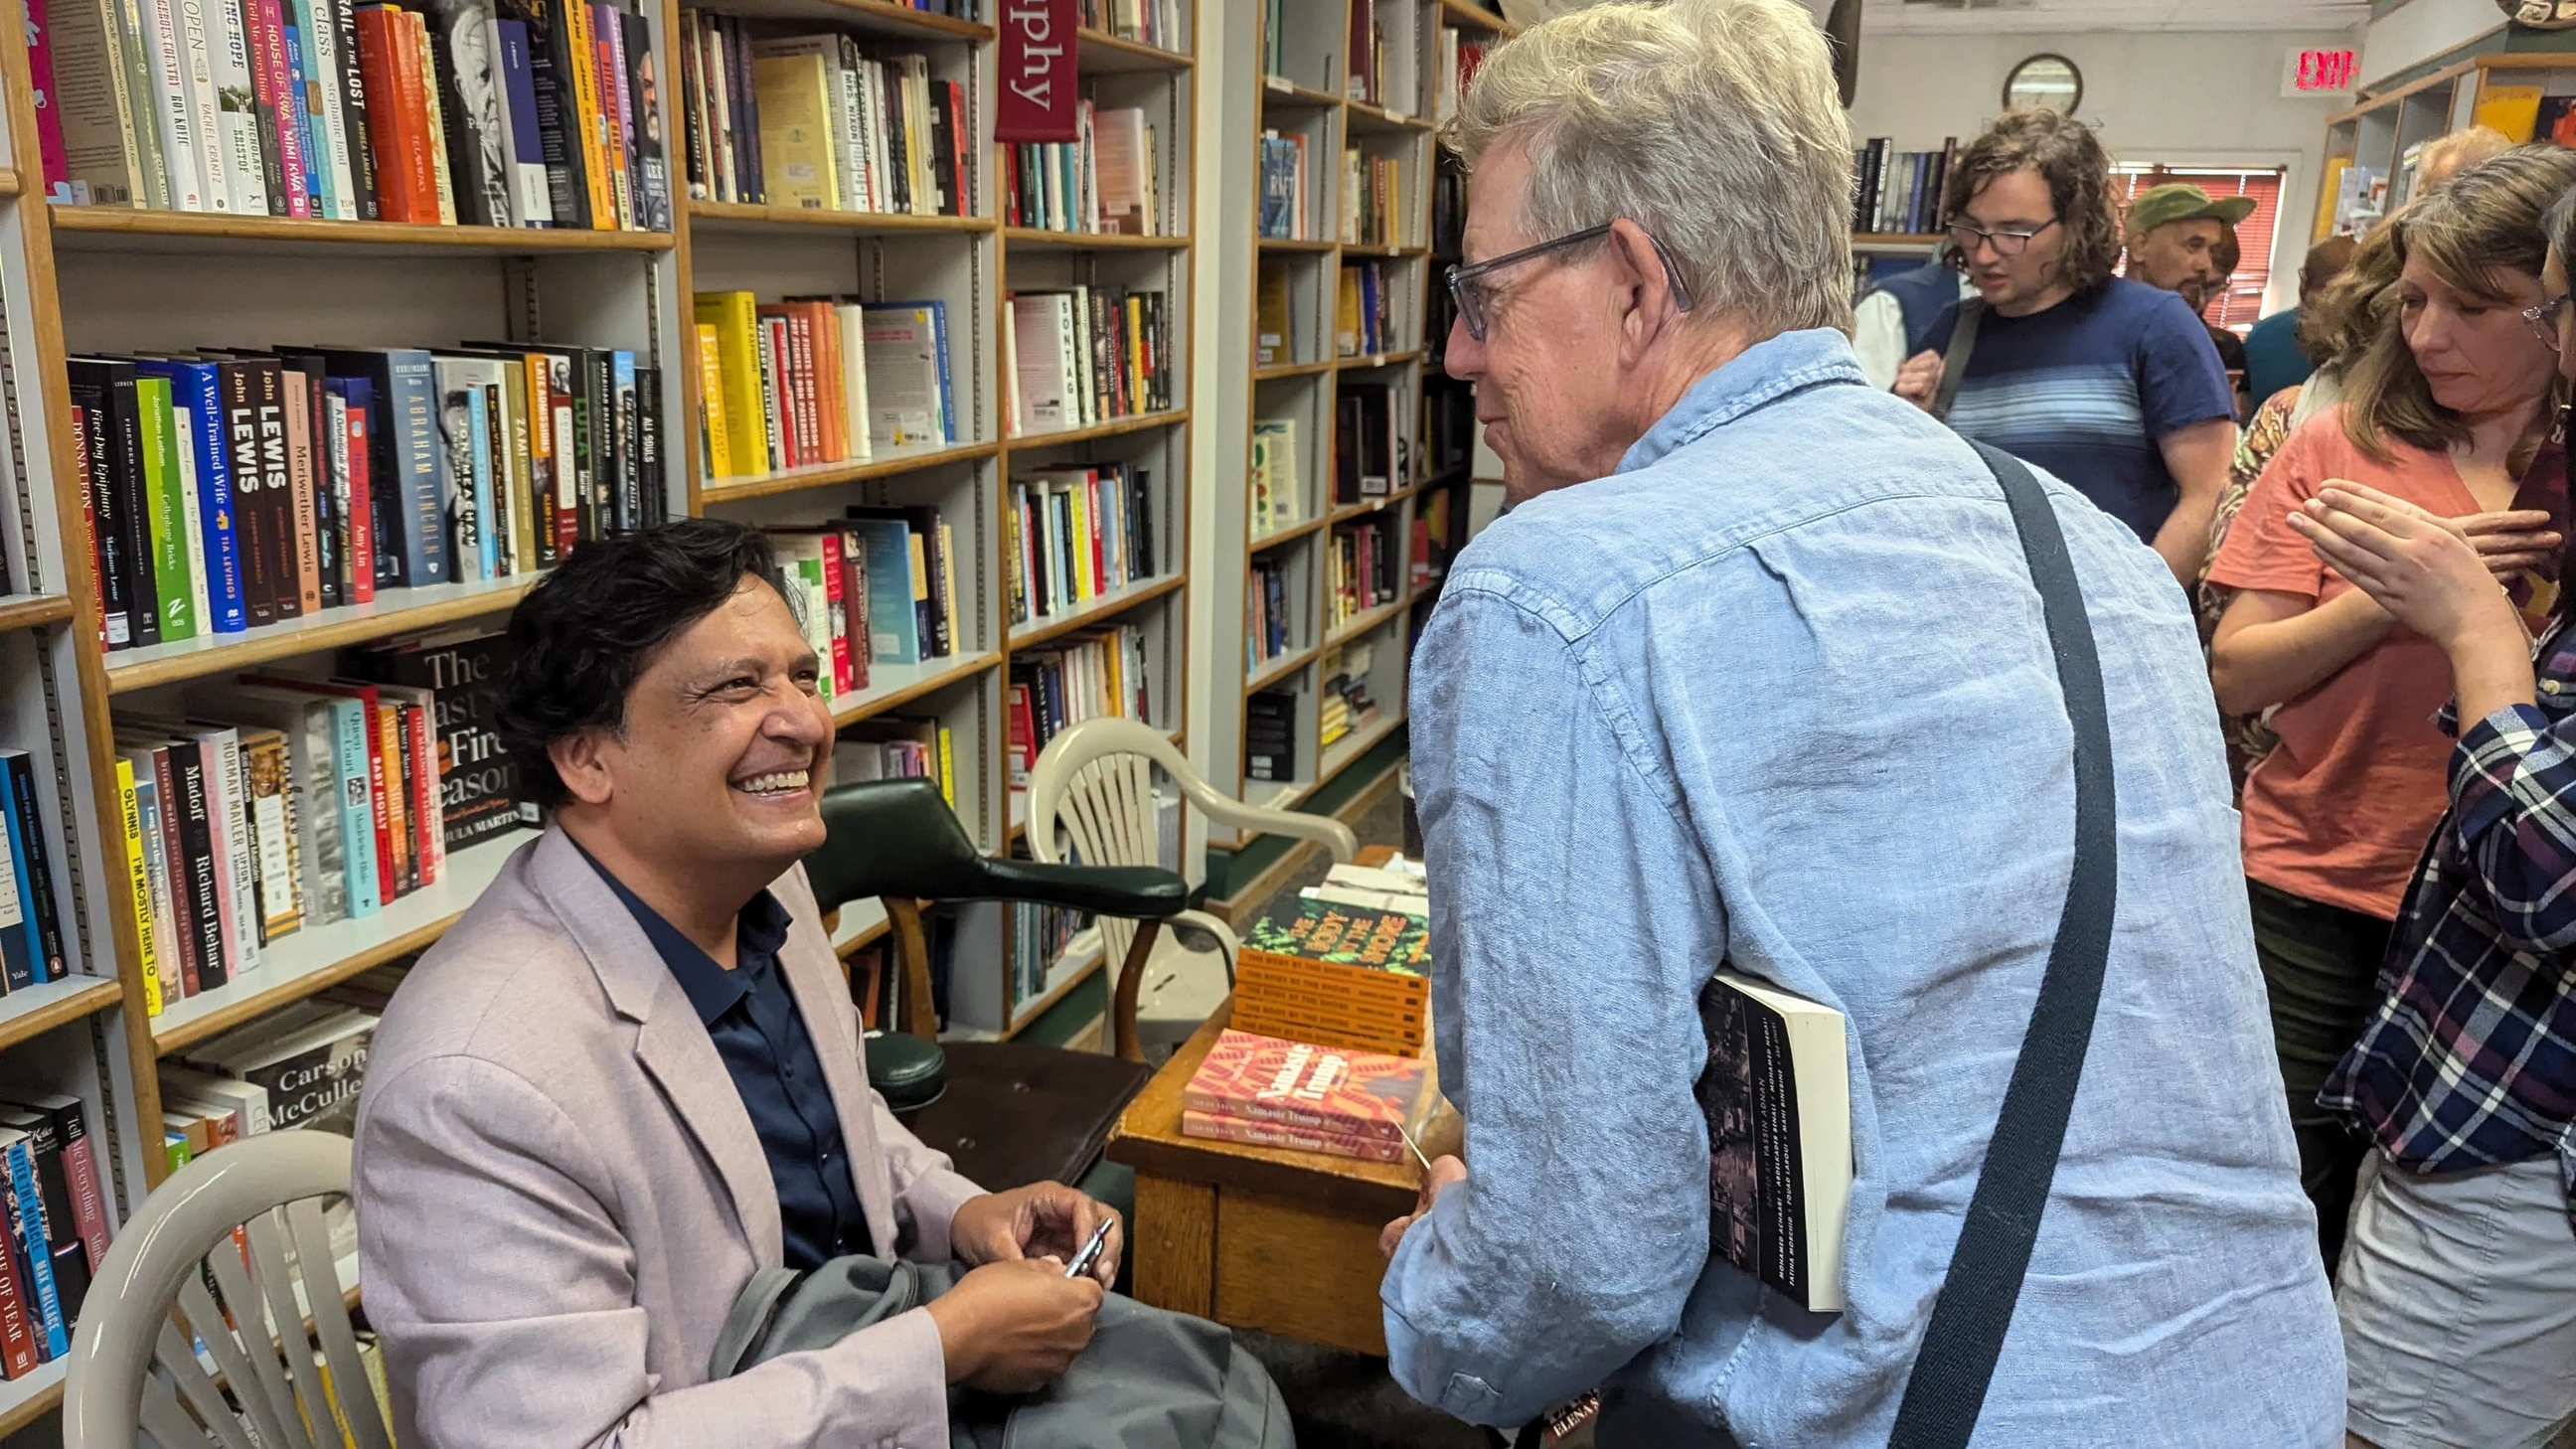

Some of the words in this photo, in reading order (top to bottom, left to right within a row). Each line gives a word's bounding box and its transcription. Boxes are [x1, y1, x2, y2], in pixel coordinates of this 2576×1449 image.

[184, 2, 205, 51] OPEN
[340, 0, 355, 32] RAIL
[229, 30, 244, 69] HOPE
[266, 24, 283, 68] HOUSE
[346, 36, 355, 46] OF
[348, 50, 358, 66] THE
[163, 43, 180, 87] COUNTRY
[253, 44, 267, 101] Everything
[274, 71, 287, 87] OF
[602, 61, 614, 96] BITING
[2298, 51, 2353, 89] EXIT
[171, 95, 184, 113] RON
[277, 89, 291, 120] KWA
[316, 7, 332, 57] class
[328, 82, 343, 138] stephanie
[336, 141, 347, 166] land
[348, 69, 365, 109] LOST
[202, 103, 215, 140] RACHEL
[607, 100, 617, 119] THE
[848, 105, 857, 139] NIXON
[174, 118, 189, 146] KOVIC
[247, 120, 260, 170] NICHOLAS
[283, 130, 297, 159] MIMI
[610, 124, 621, 152] HAND
[208, 144, 223, 183] KRANTZ
[234, 129, 248, 173] KRISTOF
[288, 162, 301, 192] KWA
[799, 317, 808, 335] TOY
[792, 337, 801, 370] FIGHTS
[801, 336, 811, 369] FIGHTS
[1061, 302, 1075, 396] SONTAG
[201, 371, 212, 381] A
[234, 372, 245, 402] John
[261, 370, 274, 401] John
[536, 362, 547, 390] LATE
[701, 334, 721, 418] Eileen
[805, 379, 814, 398] DON
[151, 396, 164, 433] Jonathan
[201, 382, 224, 469] Well-Trained
[408, 394, 431, 472] ABRAHAM
[538, 391, 551, 453] ADMISSIONS
[573, 398, 588, 456] LULA
[72, 421, 87, 470] DONNA
[87, 407, 107, 460] Five-Dog
[124, 417, 134, 464] FIREWEED
[231, 407, 258, 493] LEWIS
[258, 405, 287, 490] LEWIS
[459, 418, 469, 451] JON
[516, 418, 527, 456] ZAMI
[642, 434, 654, 462] SOULS
[766, 420, 775, 447] PAGE
[353, 453, 363, 474] Here
[79, 473, 92, 510] LEON
[93, 462, 113, 520] Epiphany
[213, 473, 228, 505] Wife
[294, 444, 312, 528] Meriwether
[354, 481, 365, 508] After
[159, 493, 175, 543] Cellophane
[417, 483, 439, 554] LINCOLN
[462, 464, 475, 547] MEACHAM
[105, 536, 116, 572] Marianne
[220, 534, 230, 551] TIA
[301, 533, 315, 572] Lewis
[353, 525, 366, 547] Amy
[166, 544, 177, 570] Bricks
[357, 551, 367, 566] Lin
[109, 575, 120, 600] Leone
[222, 555, 236, 598] LEVINGS
[424, 651, 490, 690] The
[435, 691, 478, 727] ast
[384, 716, 397, 749] WEST
[400, 724, 408, 748] Henry
[222, 740, 240, 795] NORMAN
[371, 756, 383, 786] BABY
[184, 764, 204, 821] Madoff
[375, 791, 387, 829] HOLLY
[123, 787, 139, 839] GLYNNIS
[146, 806, 156, 829] Long
[229, 799, 243, 846] MAILER
[242, 768, 252, 802] Pictures
[250, 846, 259, 882] Malcolm
[473, 809, 521, 833] MARTIN
[150, 830, 159, 848] Live
[132, 857, 144, 875] I'M
[135, 878, 150, 923] MOSTLY
[195, 855, 216, 918] Richard
[141, 926, 154, 956] HERE
[203, 920, 222, 968] Behar
[1304, 910, 1349, 952] BODY
[1360, 915, 1407, 964] SHORE
[12, 970, 29, 980] Yale
[145, 959, 157, 976] TO
[1761, 1016, 1770, 1045] NEDALI
[279, 1048, 367, 1091] Carson
[1256, 1044, 1313, 1100] Namaste
[1293, 1054, 1349, 1099] Trump
[1766, 1047, 1775, 1093] MOHAMED
[1776, 1068, 1785, 1107] BINEBINE
[266, 1078, 362, 1127] McCulle
[1244, 1104, 1285, 1119] Namaste
[1287, 1111, 1322, 1126] Trump
[67, 1117, 81, 1139] Tell
[1244, 1129, 1285, 1144] Namaste
[1287, 1135, 1322, 1150] Trump
[10, 1148, 28, 1183] AFTER
[71, 1139, 85, 1158] Me
[1772, 1134, 1781, 1187] ABDELKADER
[18, 1184, 32, 1203] THE
[74, 1160, 95, 1221] Everything
[22, 1204, 43, 1253] MIRACLE
[1775, 1197, 1784, 1232] ACHAARI
[1786, 1215, 1795, 1254] MORCHID
[34, 1259, 50, 1283] MAX
[1776, 1235, 1786, 1279] MOHAMED
[1787, 1257, 1796, 1285] FATIHA
[0, 1276, 14, 1296] OF
[4, 1301, 22, 1343] YEAR
[39, 1284, 60, 1331] WALLACE
[1553, 1396, 1600, 1438] ELENAS
